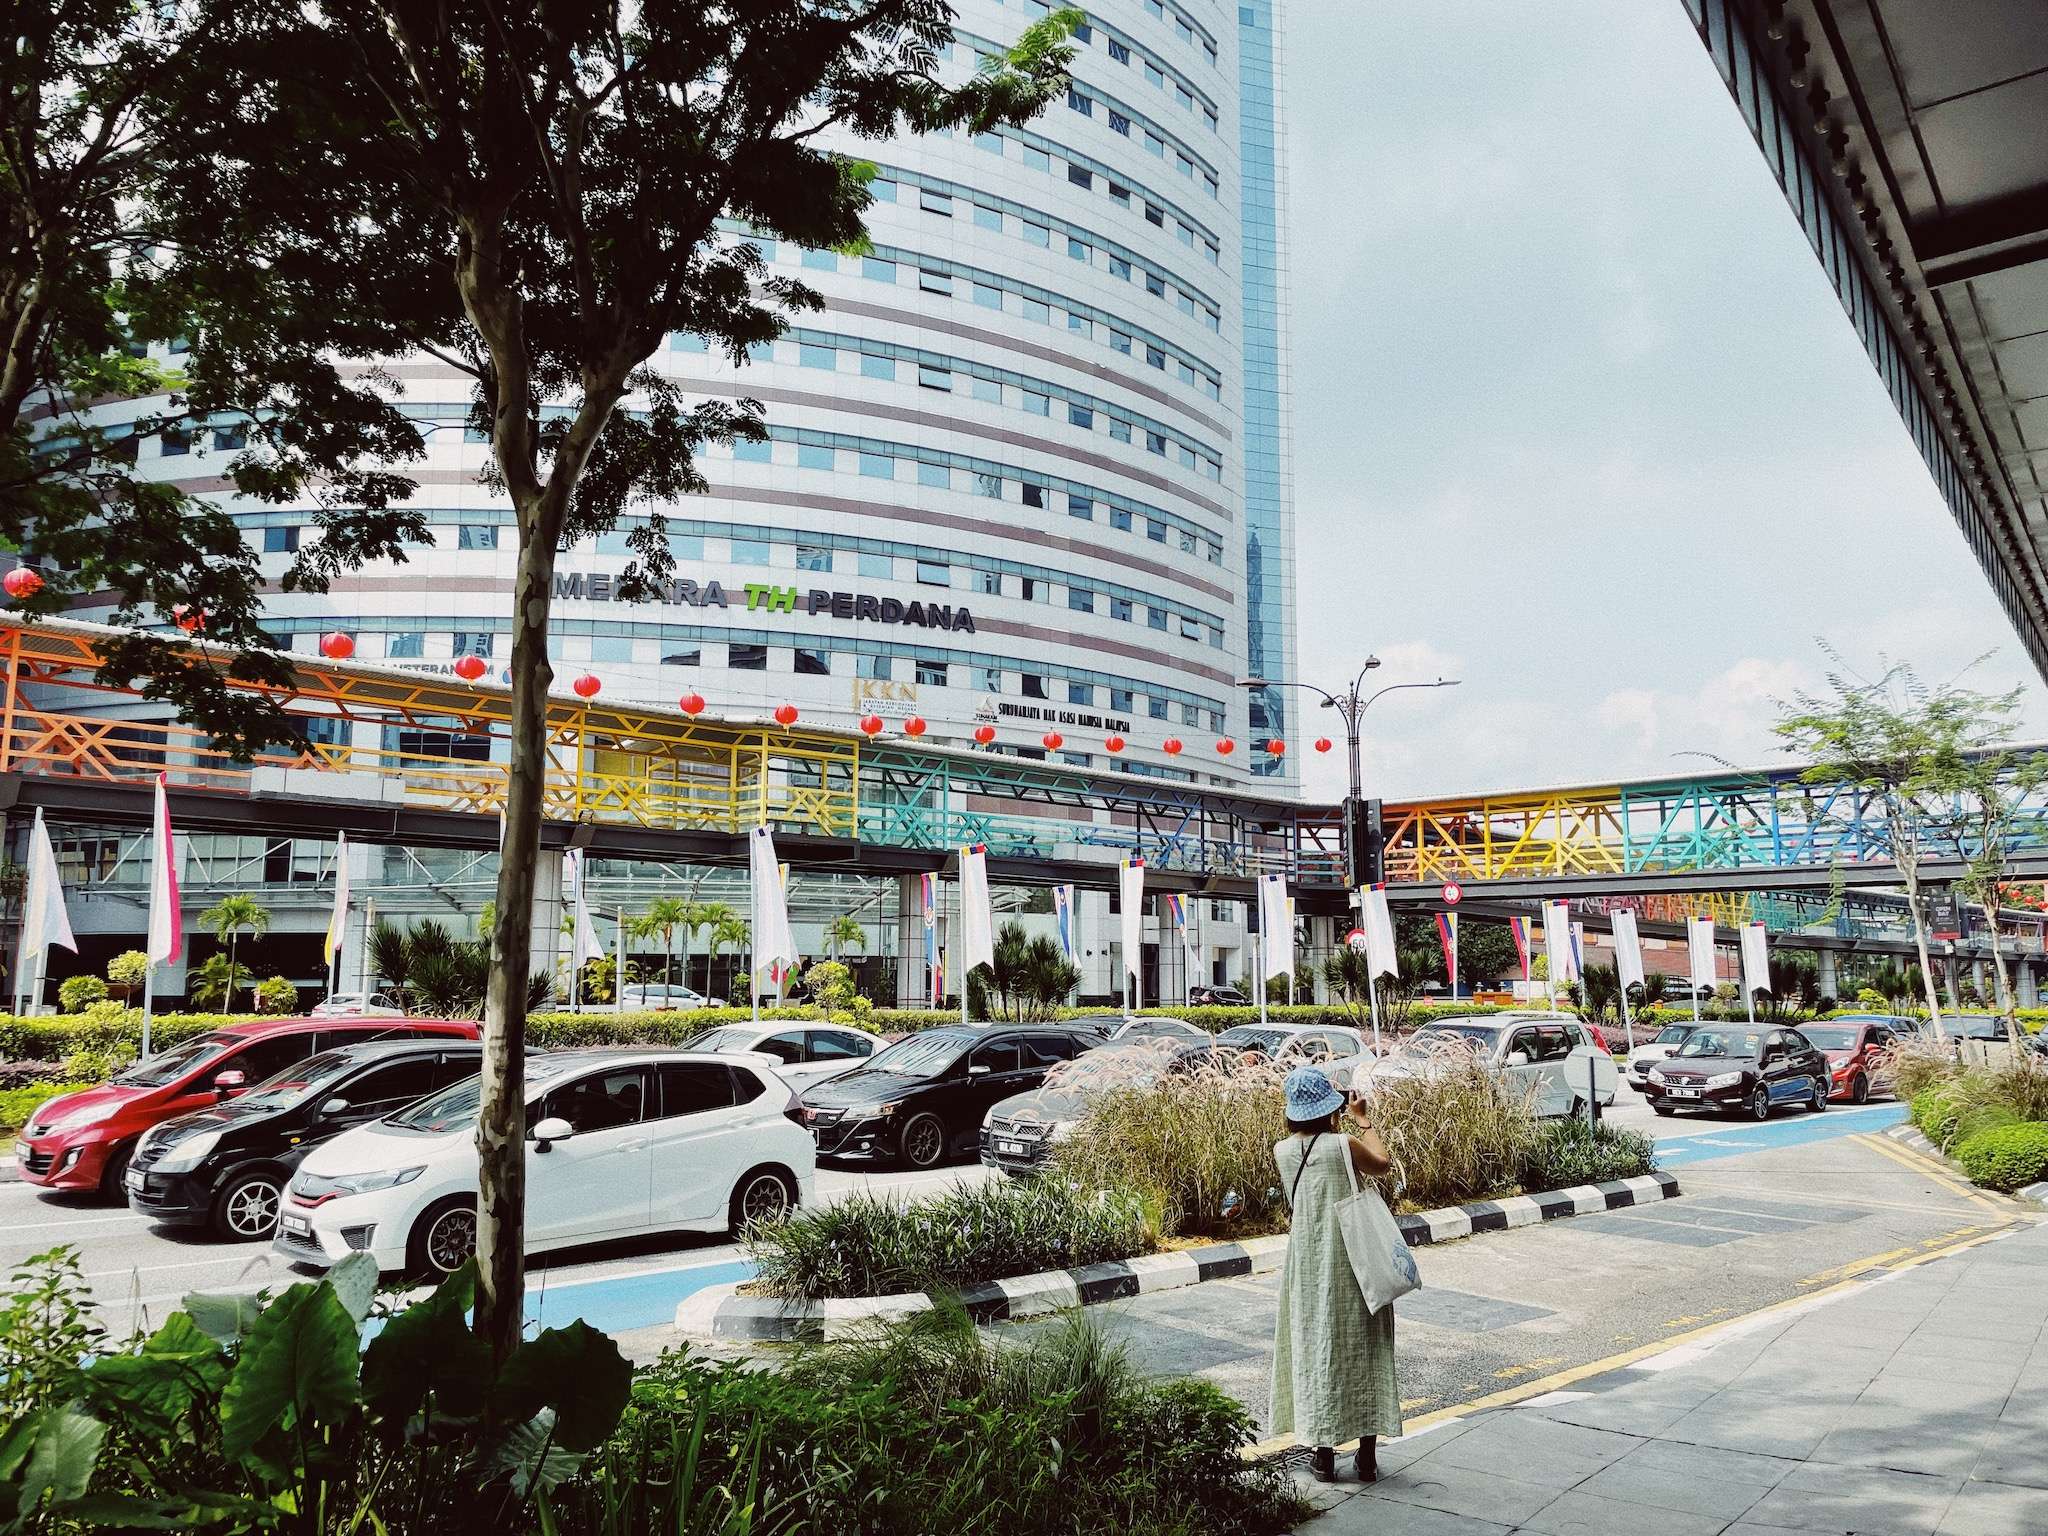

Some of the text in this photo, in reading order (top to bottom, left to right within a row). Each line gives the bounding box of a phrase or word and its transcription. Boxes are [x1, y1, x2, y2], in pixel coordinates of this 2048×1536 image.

[744, 583, 797, 613] TH
[808, 589, 976, 633] PERDANA
[1043, 708, 1056, 722] HAK
[1059, 710, 1076, 725] ASASI
[1352, 938, 1365, 950] 50
